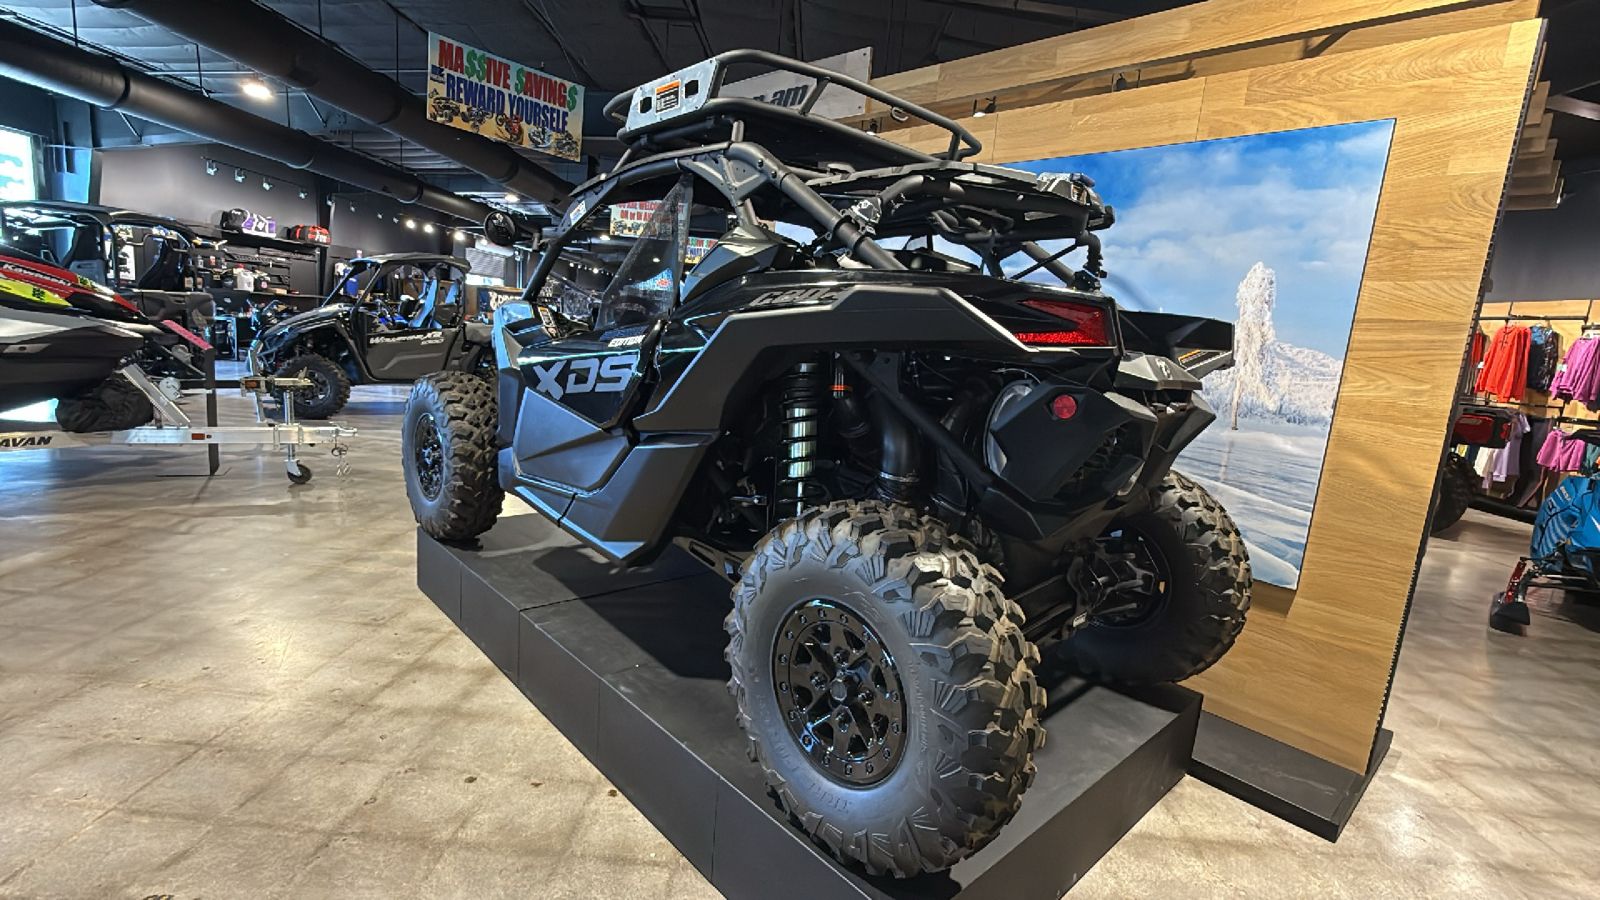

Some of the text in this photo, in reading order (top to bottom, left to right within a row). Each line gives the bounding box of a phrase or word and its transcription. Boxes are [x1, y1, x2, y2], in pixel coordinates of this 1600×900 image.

[446, 73, 506, 115] REWARD
[508, 92, 569, 134] YOURSELF
[3, 263, 72, 287] Kawasaki
[607, 334, 646, 348] EDITION
[532, 354, 638, 401] XDS
